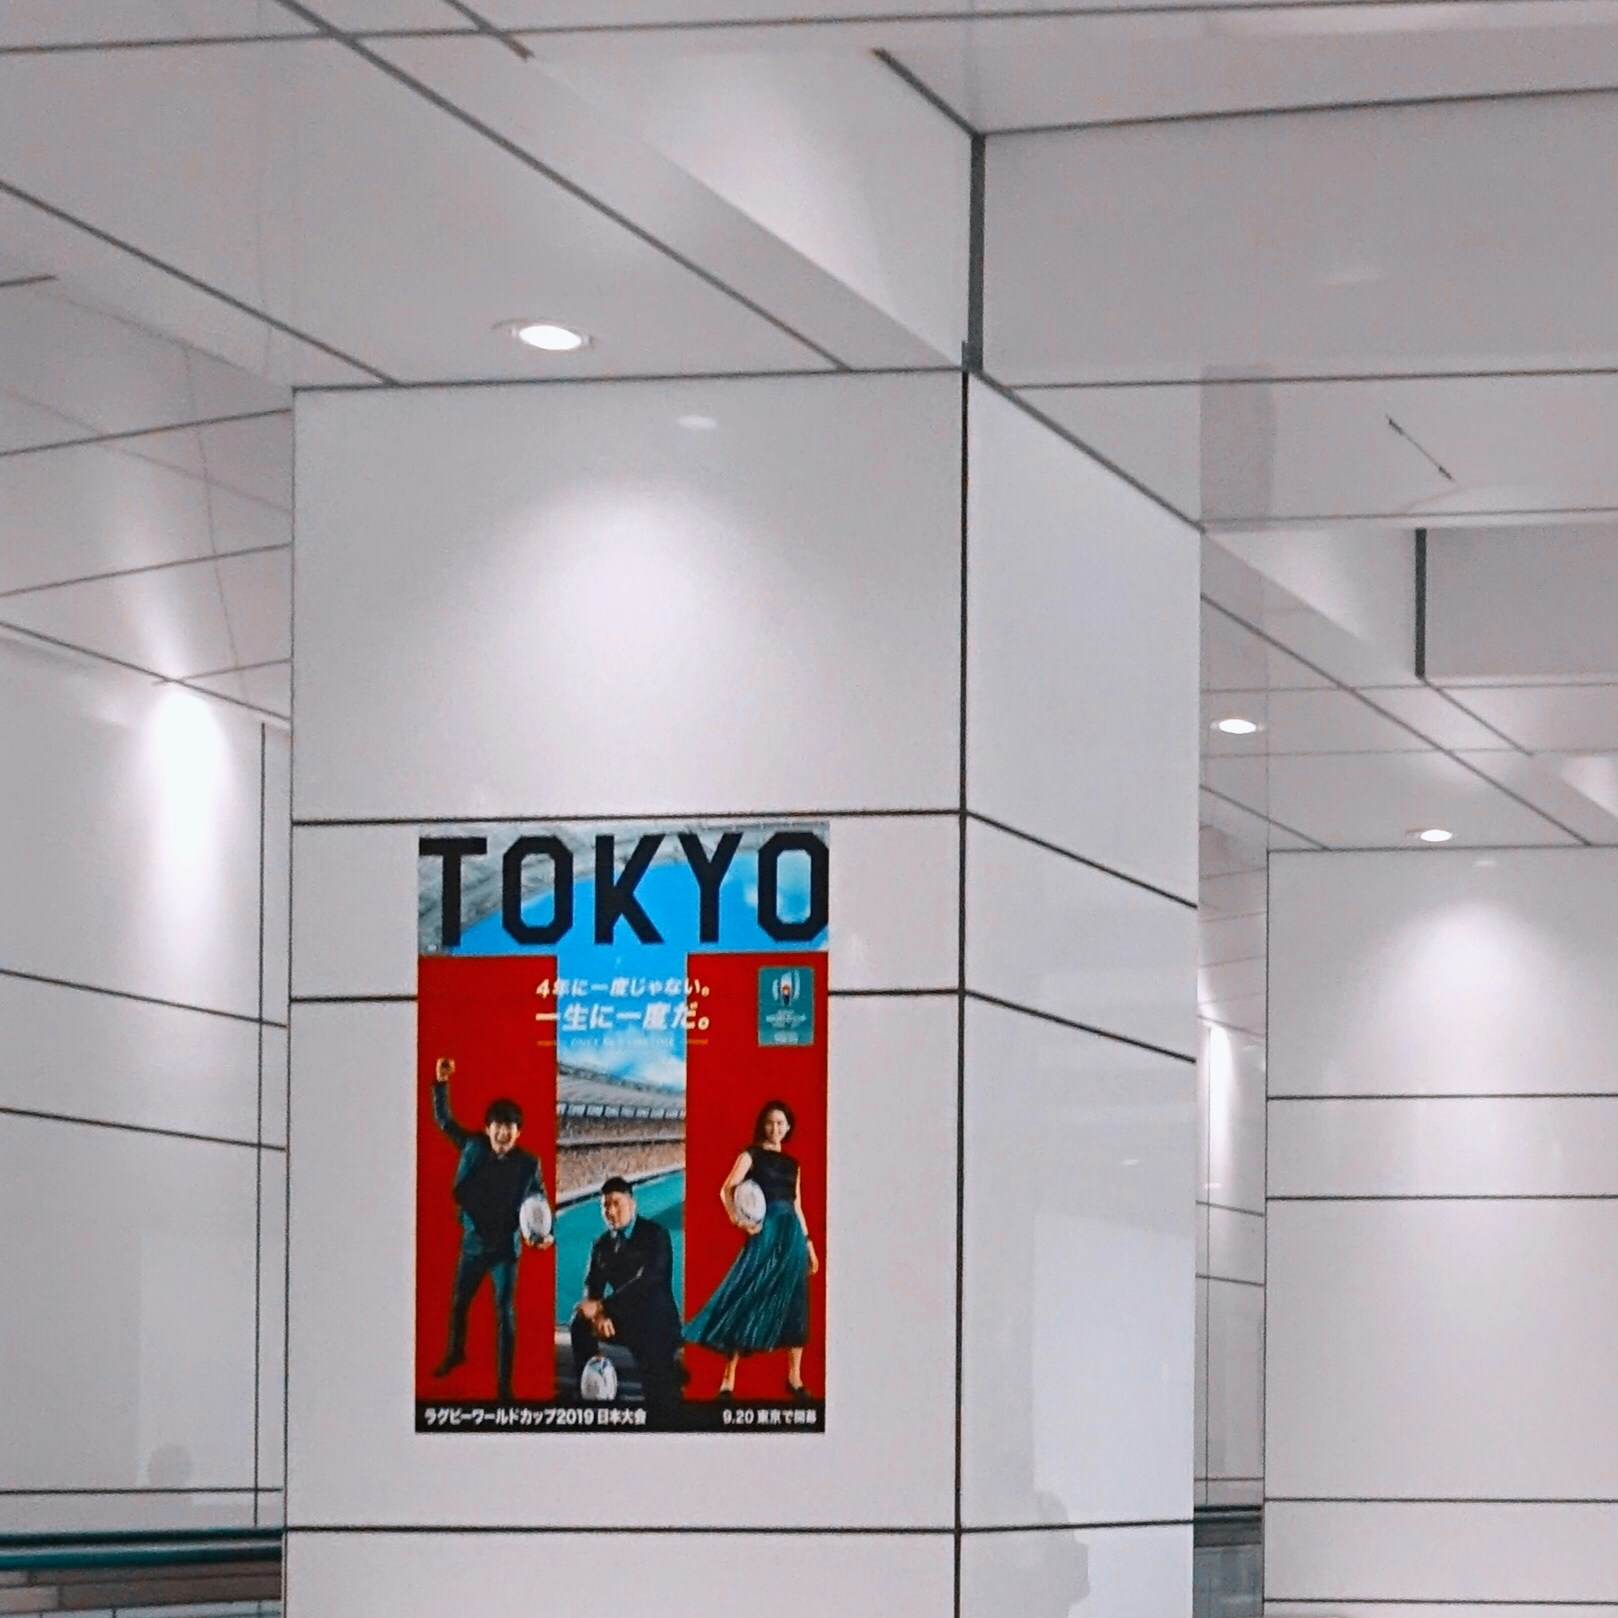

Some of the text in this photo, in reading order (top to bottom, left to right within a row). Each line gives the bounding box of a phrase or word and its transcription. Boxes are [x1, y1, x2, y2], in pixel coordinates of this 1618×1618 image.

[419, 832, 829, 945] TOKYO
[536, 977, 710, 998] 4年に一度じゃない。
[535, 1001, 710, 1031] 一生に一度だ。
[424, 1407, 647, 1426] ラグビーワールドカップ2019 日本大会
